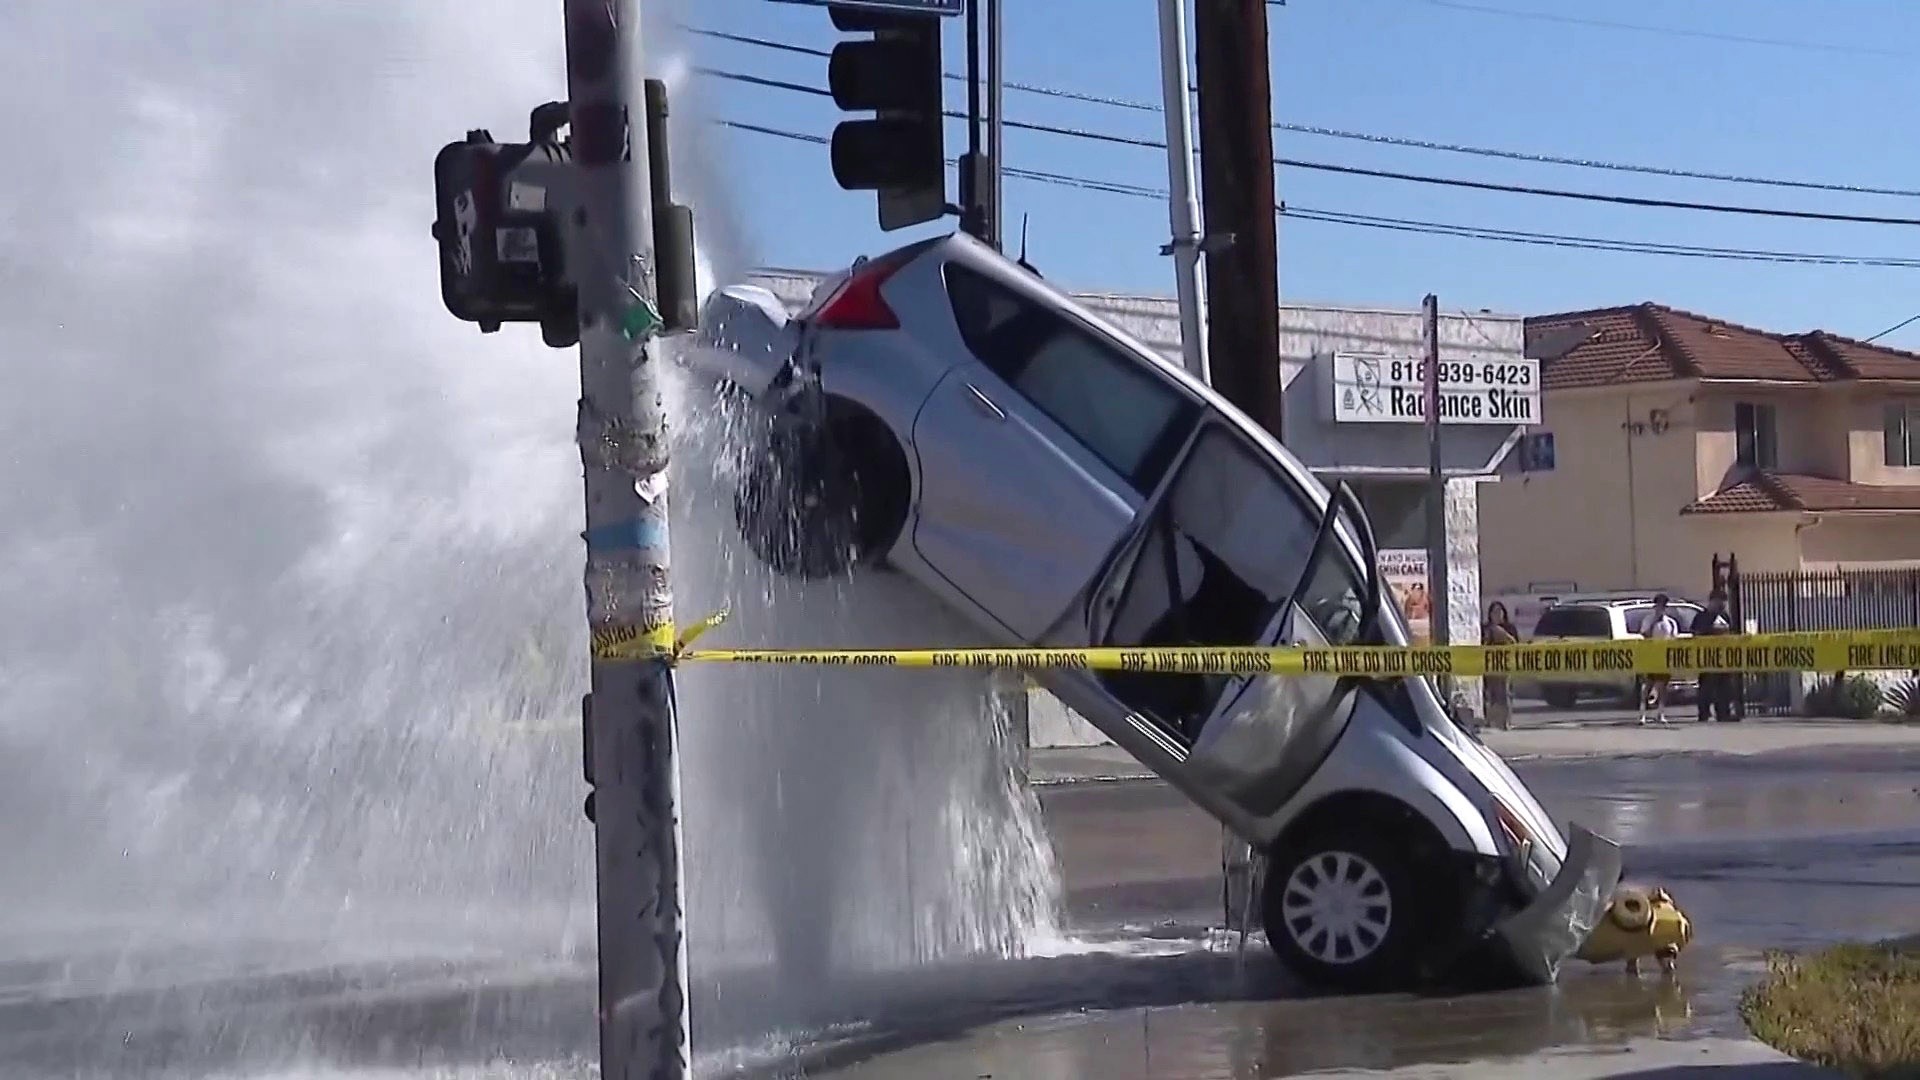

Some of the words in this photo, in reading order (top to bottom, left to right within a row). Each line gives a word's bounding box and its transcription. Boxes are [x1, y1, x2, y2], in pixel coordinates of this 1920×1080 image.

[1391, 385, 1482, 417] Radance
[1488, 388, 1531, 418] Skin
[995, 653, 1013, 668] DO
[1016, 653, 1040, 668] NOT
[1120, 652, 1147, 672] FIRE
[1152, 652, 1179, 672] LINE
[1181, 652, 1199, 672] DO
[1201, 652, 1226, 672] NOT
[1230, 652, 1271, 672] CROSS
[1303, 651, 1329, 672] FIRE
[1334, 651, 1360, 672] LINE
[1363, 651, 1380, 672] DO
[1383, 651, 1407, 672] NOT
[1411, 651, 1452, 672] CROSS
[1484, 649, 1511, 672] FIRE
[1515, 649, 1542, 672] LINE
[1544, 649, 1561, 672] DO
[1565, 649, 1588, 672] NOT
[1592, 649, 1634, 672] CROSS
[1666, 647, 1691, 668] FIRE
[1696, 647, 1723, 668] LINE
[1725, 647, 1742, 668] DO
[1747, 647, 1769, 668] NOT
[1773, 647, 1815, 668] CROSS
[1848, 644, 1873, 666] FIRE
[1879, 644, 1904, 666] LINE
